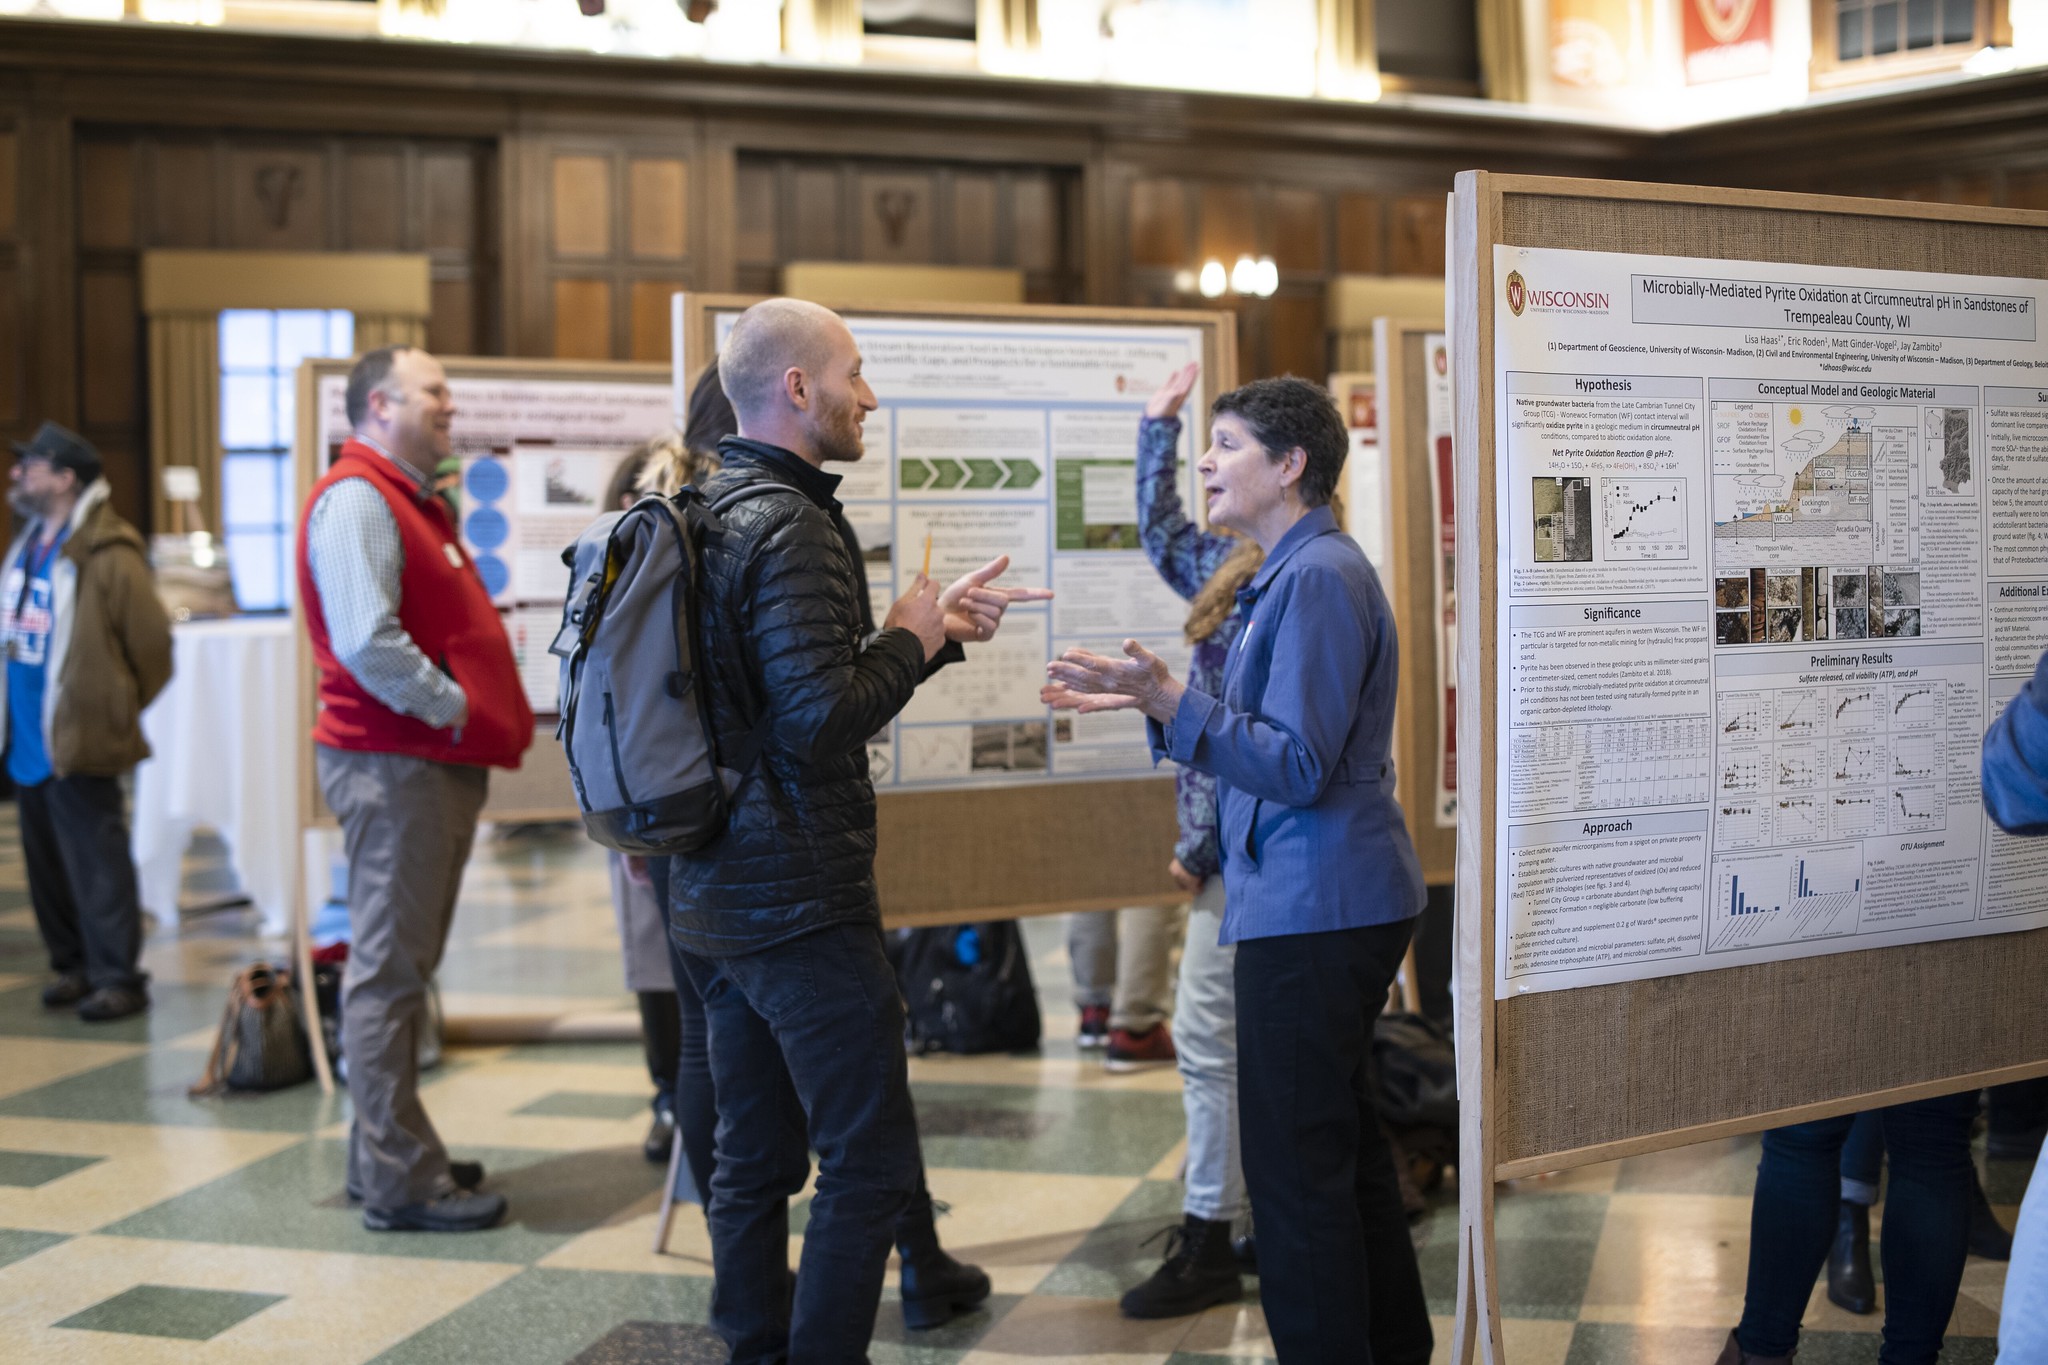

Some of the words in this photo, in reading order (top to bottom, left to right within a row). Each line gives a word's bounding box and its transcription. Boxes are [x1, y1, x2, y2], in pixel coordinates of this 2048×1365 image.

[1527, 290, 1609, 309] WISCONSIN
[1643, 280, 1762, 298] Microbially-Mediated
[1765, 286, 1796, 302] Pyrite
[1799, 288, 1848, 303] Oxidation
[1851, 292, 1862, 304] at
[1864, 292, 1934, 308] Circumneutral
[1937, 296, 1950, 311] pH
[1953, 297, 1962, 310] in
[1964, 298, 2017, 313] Sandstones
[2019, 300, 2029, 314] of
[1784, 309, 1853, 326] Trempealeau
[1855, 313, 1894, 330] County,
[1896, 315, 1910, 328] WI
[1745, 335, 1759, 344] Lisa
[1788, 336, 1801, 346] Eric
[1832, 338, 1849, 348] Matt
[1900, 342, 1911, 352] Jay
[1548, 342, 1557, 351] (1)
[1558, 343, 1599, 352] Department
[1609, 345, 1648, 354] Geoscience,
[1649, 346, 1682, 355] University
[1726, 349, 1755, 357] Madison,
[1756, 350, 1764, 358] (2)
[1792, 351, 1834, 359] Environmental
[1835, 352, 1870, 362] Engineering,
[1871, 354, 1899, 363] University
[1940, 357, 1965, 365] Madison,
[1974, 358, 2006, 366] Department
[1576, 379, 1632, 392] Hypothesis
[1758, 383, 1808, 397] Conceptual
[1811, 385, 1839, 396] Model
[1841, 386, 1858, 396] and
[1860, 386, 1898, 400] Geologic
[1900, 388, 1935, 399] Material
[1684, 403, 1696, 411] City
[1565, 449, 1584, 458] Pyrite
[1654, 450, 1674, 459] pH=7:
[2000, 586, 2040, 597] Additional
[1584, 608, 1641, 622] Significance
[1811, 655, 1860, 667] Preliminary
[1862, 652, 1893, 664] Results
[1799, 675, 1819, 684] Sulfate
[1820, 673, 1844, 682] released,
[1845, 672, 1855, 680] cell
[1856, 672, 1878, 680] viability
[1879, 670, 1896, 680] (ATP),
[1909, 670, 1918, 678] pH
[1520, 708, 1542, 716] organic
[1543, 705, 1587, 714] carbon-depleted
[1583, 820, 1632, 836] Approach
[1552, 845, 1571, 853] aquifer
[1913, 840, 1945, 850] Assignment
[1519, 860, 1540, 868] pumping
[1515, 932, 1536, 940] Duplicate
[1583, 923, 1615, 932] supplement
